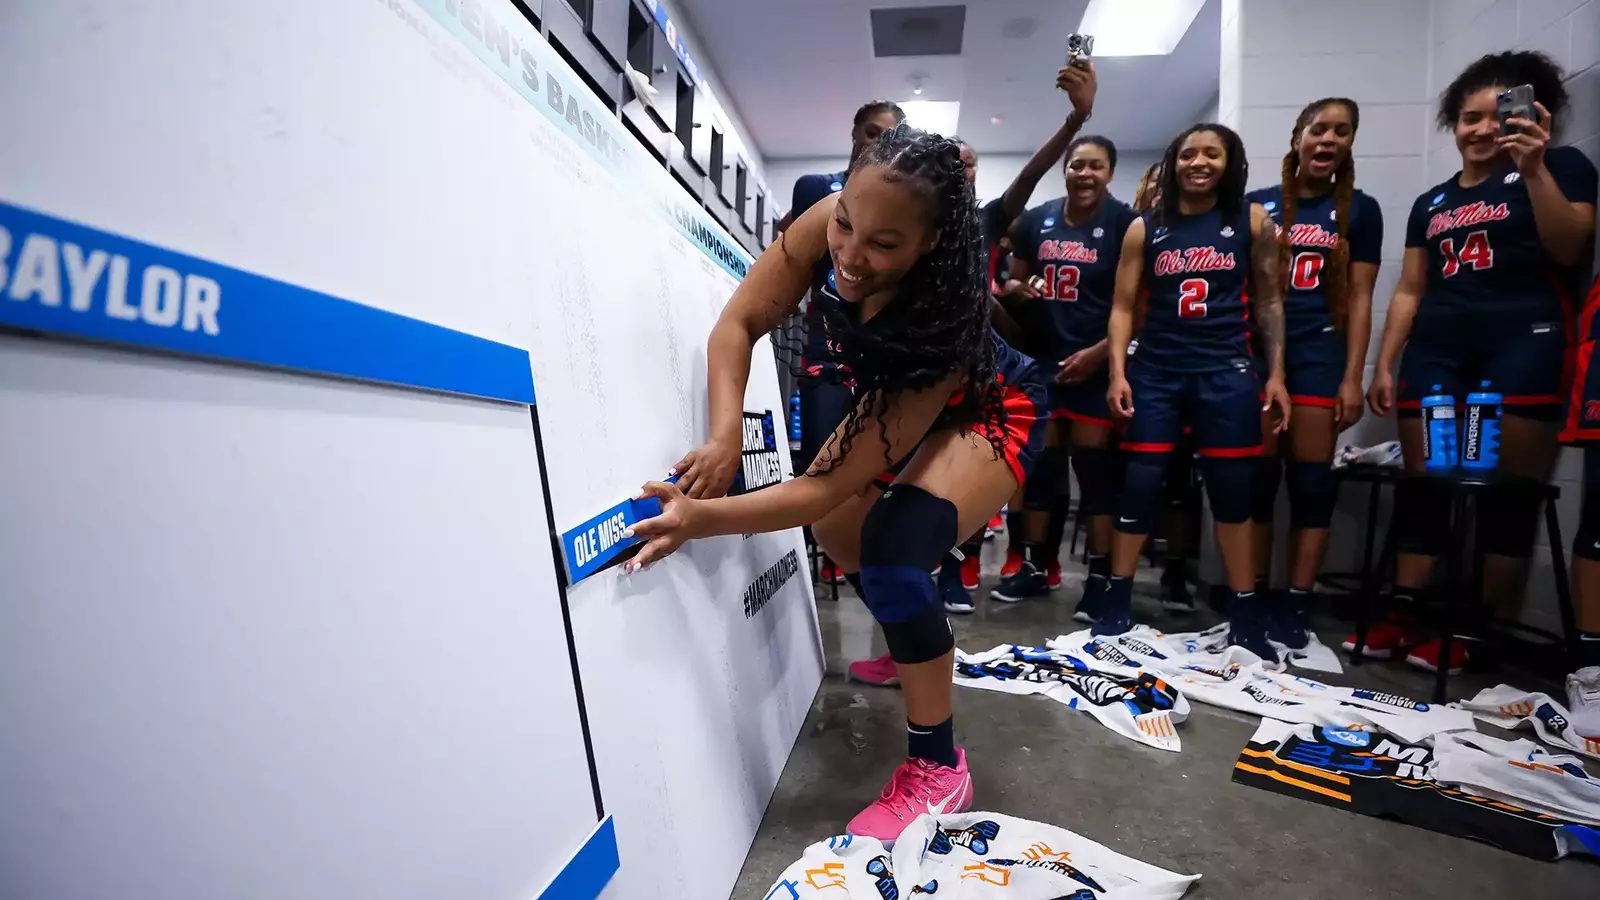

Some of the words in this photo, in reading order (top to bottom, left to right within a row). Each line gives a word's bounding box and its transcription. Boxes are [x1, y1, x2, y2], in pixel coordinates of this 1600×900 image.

[1451, 201, 1511, 230] Miss
[673, 201, 747, 278] CHAMPIONSHIP
[1059, 241, 1098, 264] Miss
[1439, 230, 1494, 279] 14
[1155, 249, 1186, 277] Ole
[1184, 246, 1236, 273] Miss
[1043, 264, 1081, 302] 12
[1178, 278, 1209, 318] 2
[742, 417, 765, 451] ARCH
[1466, 405, 1480, 460] POWERADE
[742, 451, 781, 491] MADNESS
[574, 528, 599, 568] OLE
[597, 511, 627, 553] MISS
[743, 548, 798, 620] #MARCHMADNESS
